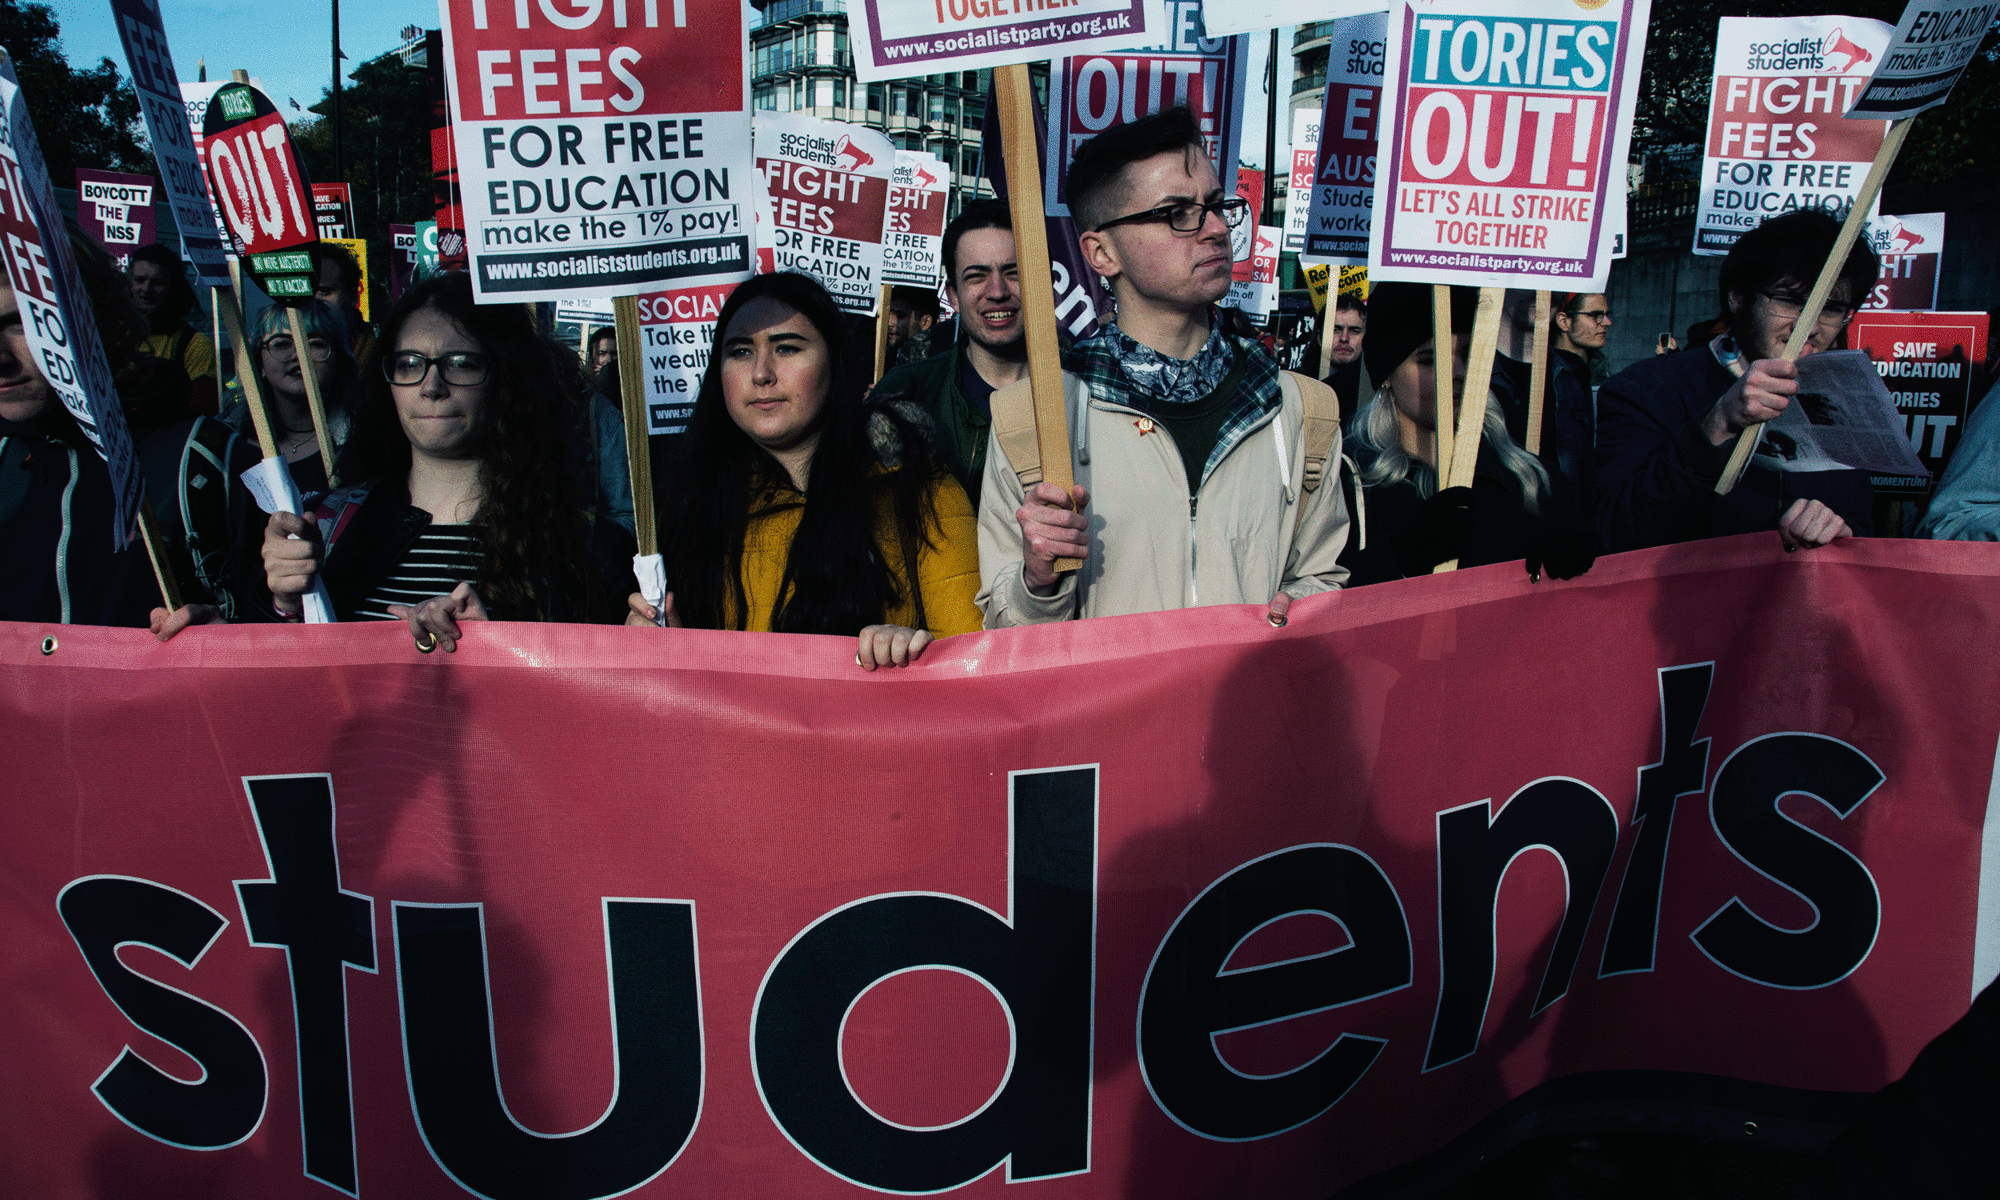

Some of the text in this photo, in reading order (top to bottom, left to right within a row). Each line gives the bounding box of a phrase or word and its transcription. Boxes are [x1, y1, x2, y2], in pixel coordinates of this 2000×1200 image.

[883, 13, 1131, 59] www.socialistparty.org.uk
[1905, 3, 1997, 43] EDUCATION
[1418, 19, 1610, 88] TORIES
[1749, 37, 1822, 56] socialist
[1885, 47, 1928, 71] make
[1747, 54, 1824, 70] students
[477, 46, 645, 116] FEES
[220, 90, 252, 116] TORIES
[1076, 58, 1219, 131] OUT!
[1725, 77, 1863, 114] FIGHT
[483, 119, 703, 168] FOR FREE
[780, 133, 835, 152] socialist
[1411, 91, 1597, 187] OUT!
[1720, 122, 1818, 159] FEES
[779, 144, 837, 166] students
[211, 124, 307, 245] OUT
[766, 160, 865, 204] FIGHT
[1716, 162, 1852, 188] FOR FREE
[85, 185, 148, 202] BOYCOTT
[488, 168, 729, 215] EDUCATION
[98, 205, 123, 220] THE
[1401, 188, 1591, 222] LET'S ALL STRIKE
[484, 219, 571, 245] make
[580, 216, 626, 240] the
[637, 210, 673, 235] 1%
[681, 204, 739, 236] pay!
[1706, 211, 1754, 227] make
[107, 225, 135, 240] NSS
[895, 234, 928, 248] FREE
[1435, 219, 1548, 249] TOGETHER
[486, 243, 741, 279] www.socialiststudents.org.uk
[811, 236, 860, 260] FREE
[777, 251, 870, 281] UCATION
[883, 260, 897, 269] the
[915, 264, 935, 274] pay!
[1391, 252, 1583, 274] www.socialistparty.org.uk
[842, 282, 872, 294] pay!
[1241, 291, 1254, 300] off
[645, 325, 695, 346] Take
[1893, 342, 1937, 358] SAVE
[654, 375, 687, 394] the
[56, 661, 1886, 1200] students
